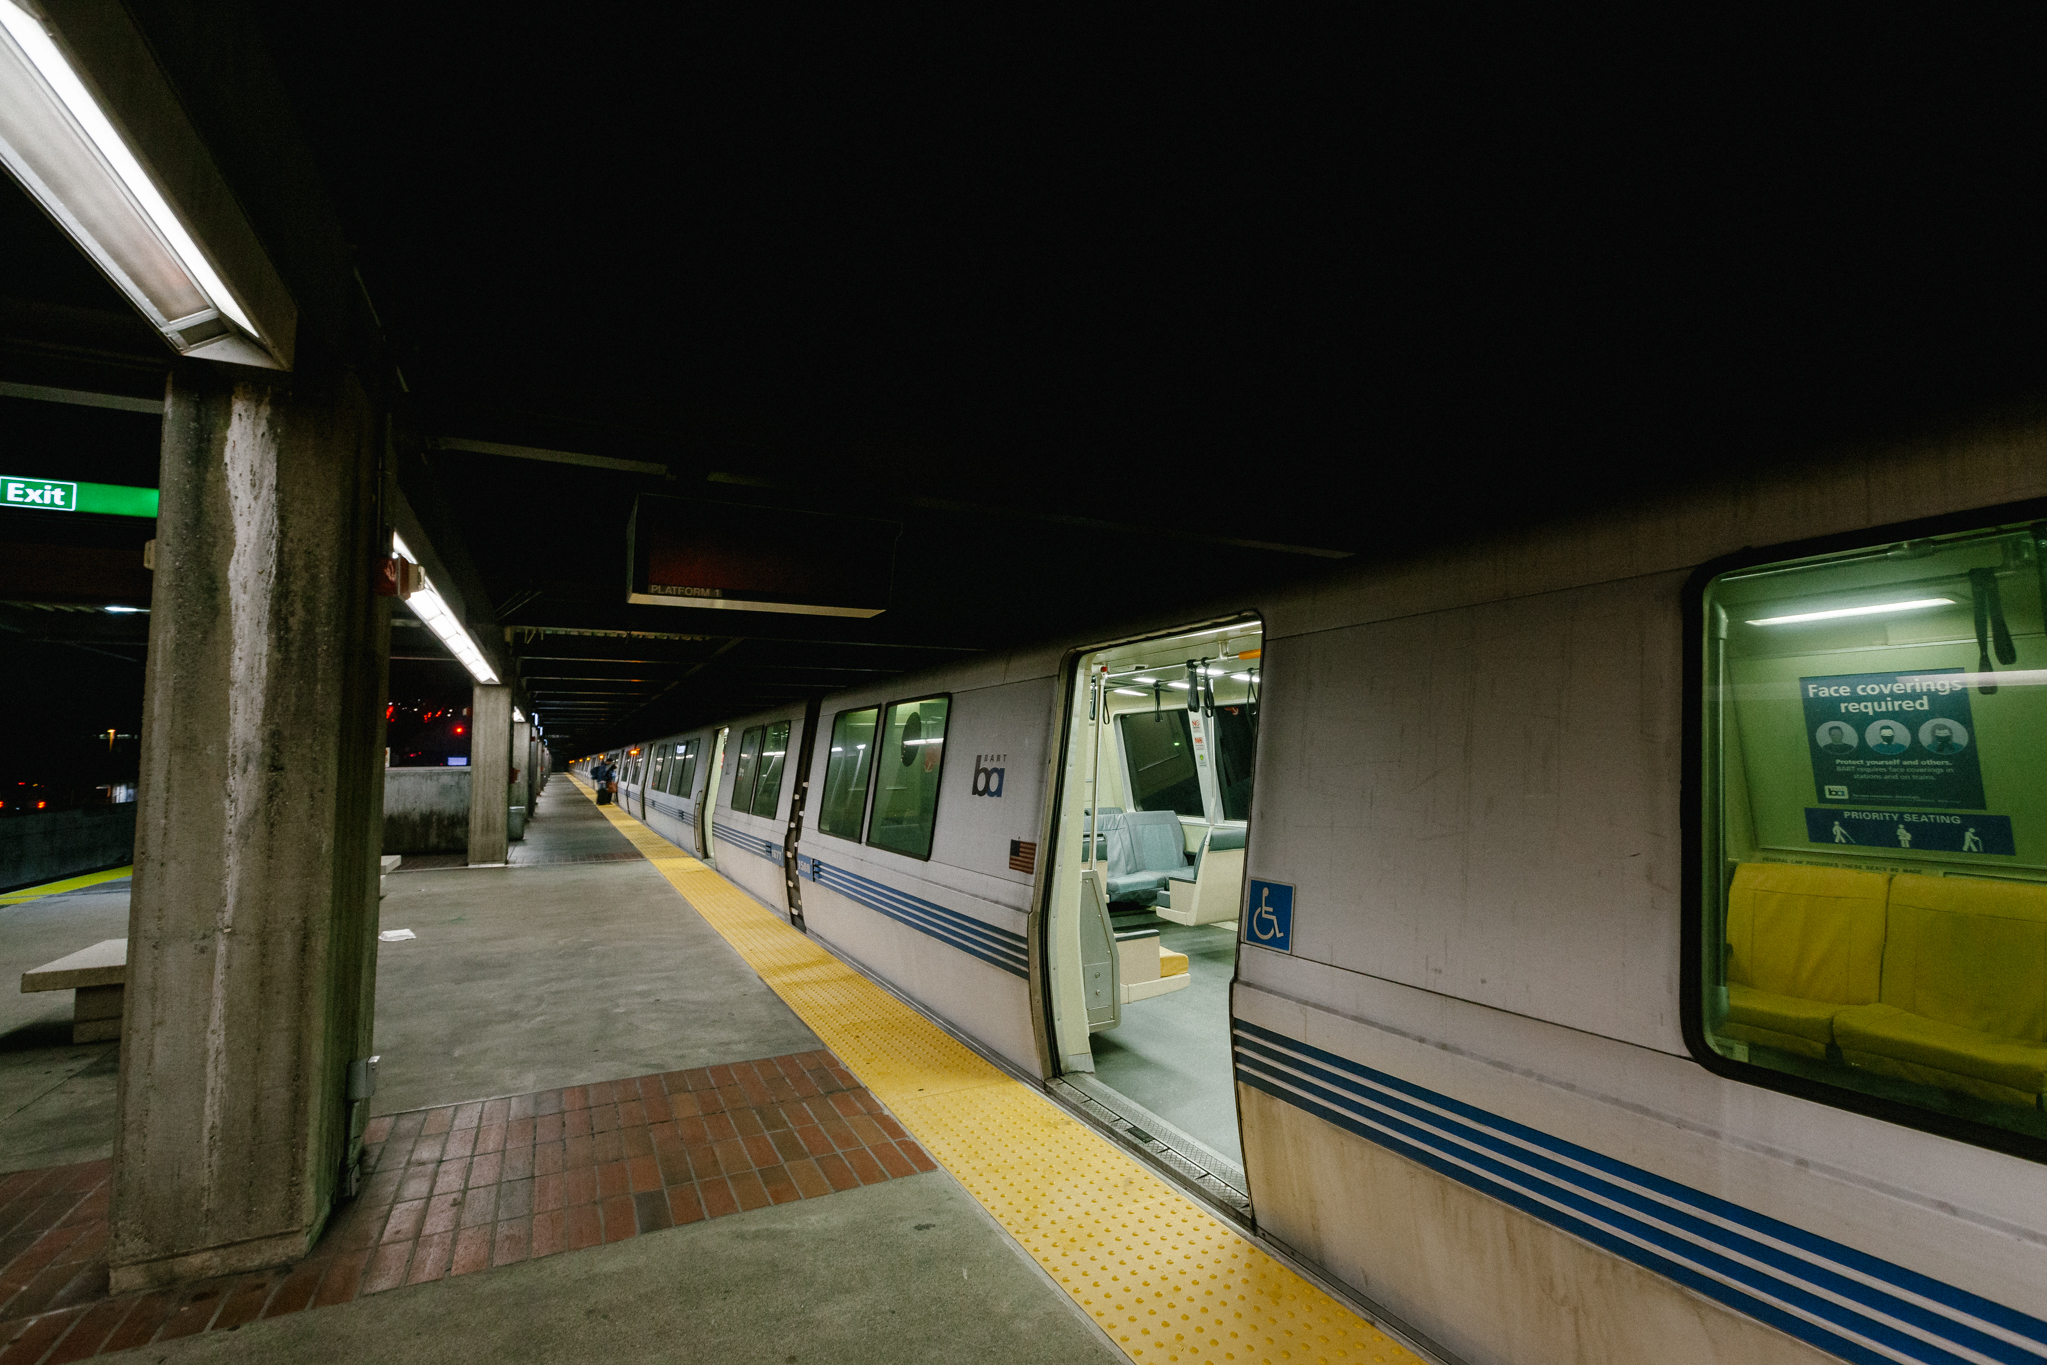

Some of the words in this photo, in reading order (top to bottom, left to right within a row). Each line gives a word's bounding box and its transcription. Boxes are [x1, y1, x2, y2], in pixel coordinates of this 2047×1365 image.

[7, 482, 66, 506] Exit
[651, 585, 710, 597] PLATFORM
[714, 589, 720, 597] 1
[1807, 684, 1851, 698] Face
[1857, 679, 1962, 695] coverings
[1840, 696, 1929, 715] required
[984, 754, 1008, 762] BART
[1835, 758, 1865, 766] Protect
[1866, 758, 1900, 767] yourself
[1902, 758, 1919, 766] and
[1857, 766, 1888, 774] requires
[1906, 766, 1944, 775] coverings
[1843, 811, 1899, 821] PRIORITY
[1903, 813, 1961, 824] SEATING
[1865, 865, 1887, 873] SEATS
